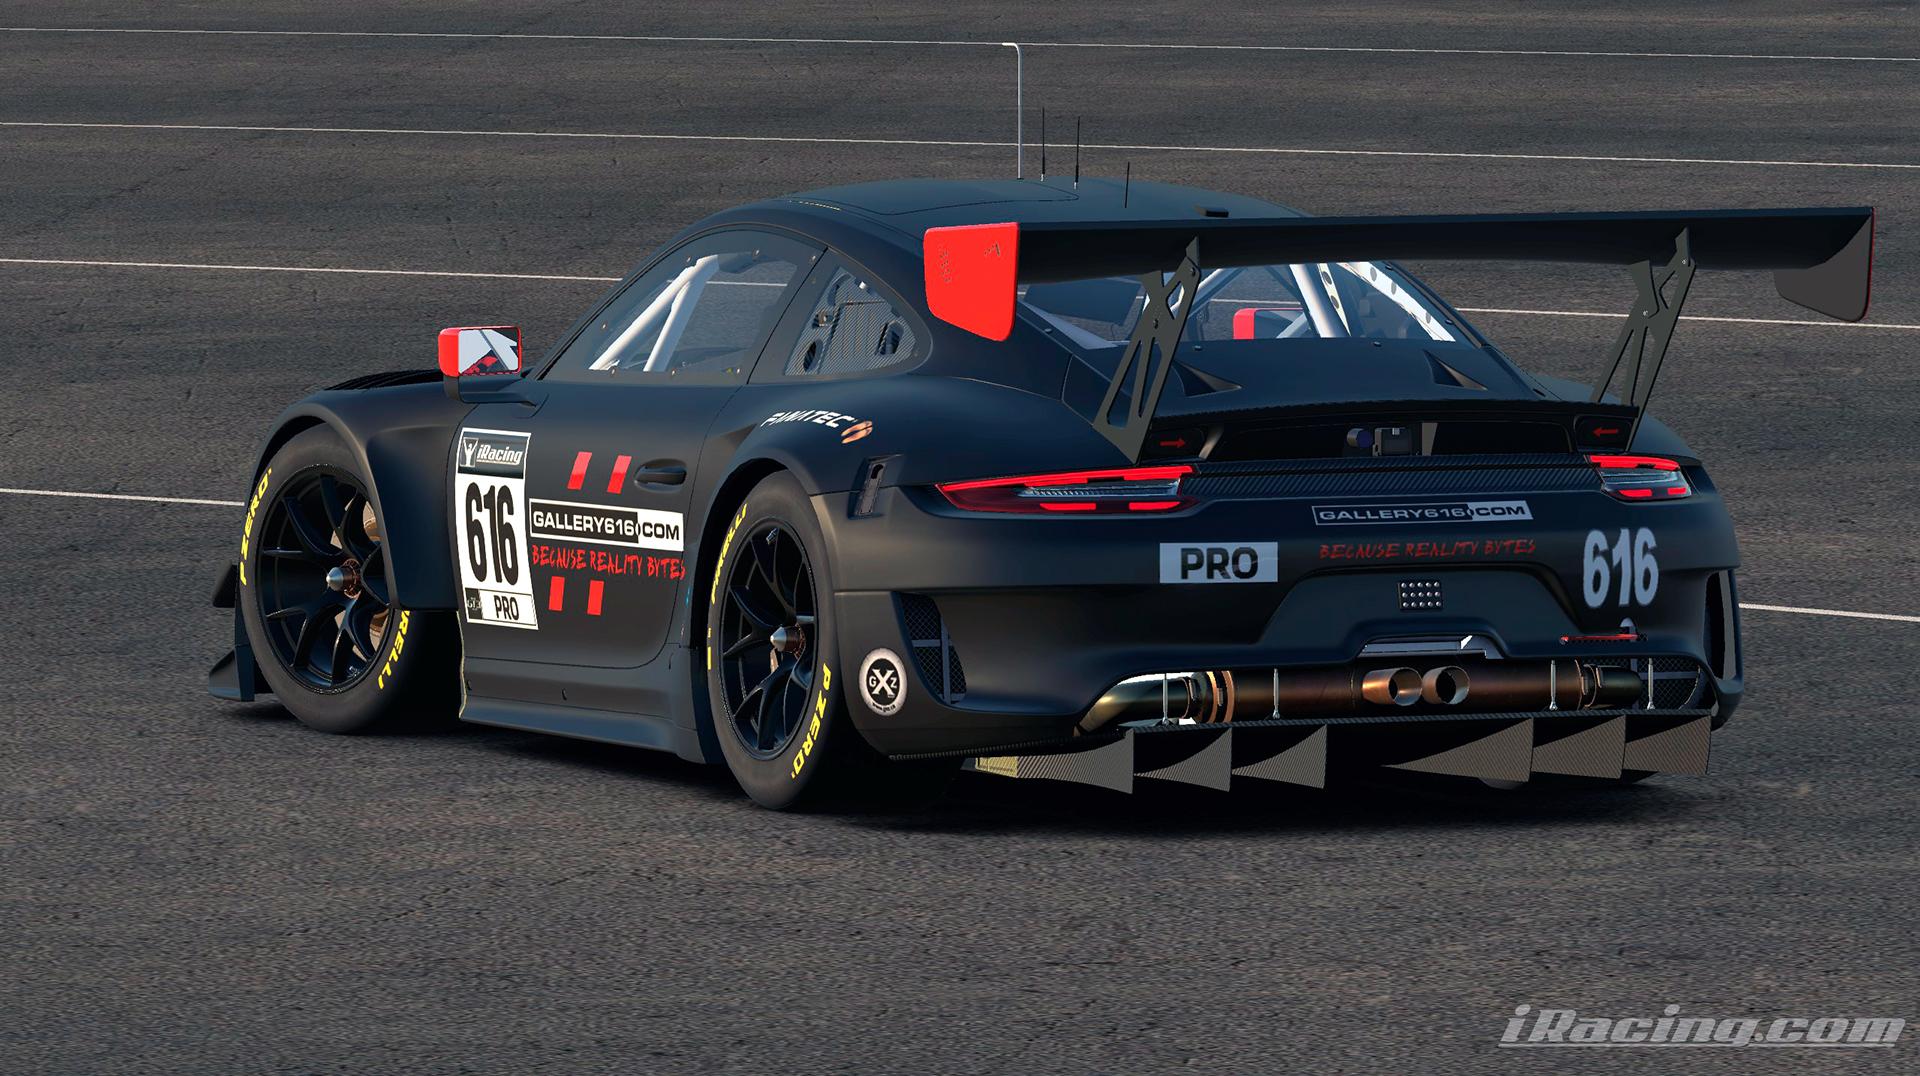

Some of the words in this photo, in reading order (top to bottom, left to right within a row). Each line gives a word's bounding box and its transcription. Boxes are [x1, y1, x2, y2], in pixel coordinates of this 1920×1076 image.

[760, 410, 857, 428] FANATEC
[477, 444, 523, 465] iRacing
[241, 469, 271, 560] ZERO
[466, 482, 518, 585] 616
[1319, 543, 1401, 560] BECAUSE
[1405, 540, 1479, 558] REALITY
[1484, 538, 1536, 555] BYTES
[532, 544, 586, 570] BECAUSE
[589, 550, 642, 577] REALITY
[647, 556, 685, 580] BYTES
[1181, 547, 1259, 579] PRO
[1583, 527, 1659, 608] 616
[494, 595, 519, 620] PRO
[378, 610, 410, 689] RELLI
[823, 663, 832, 691] P
[793, 690, 827, 776] ZERO
